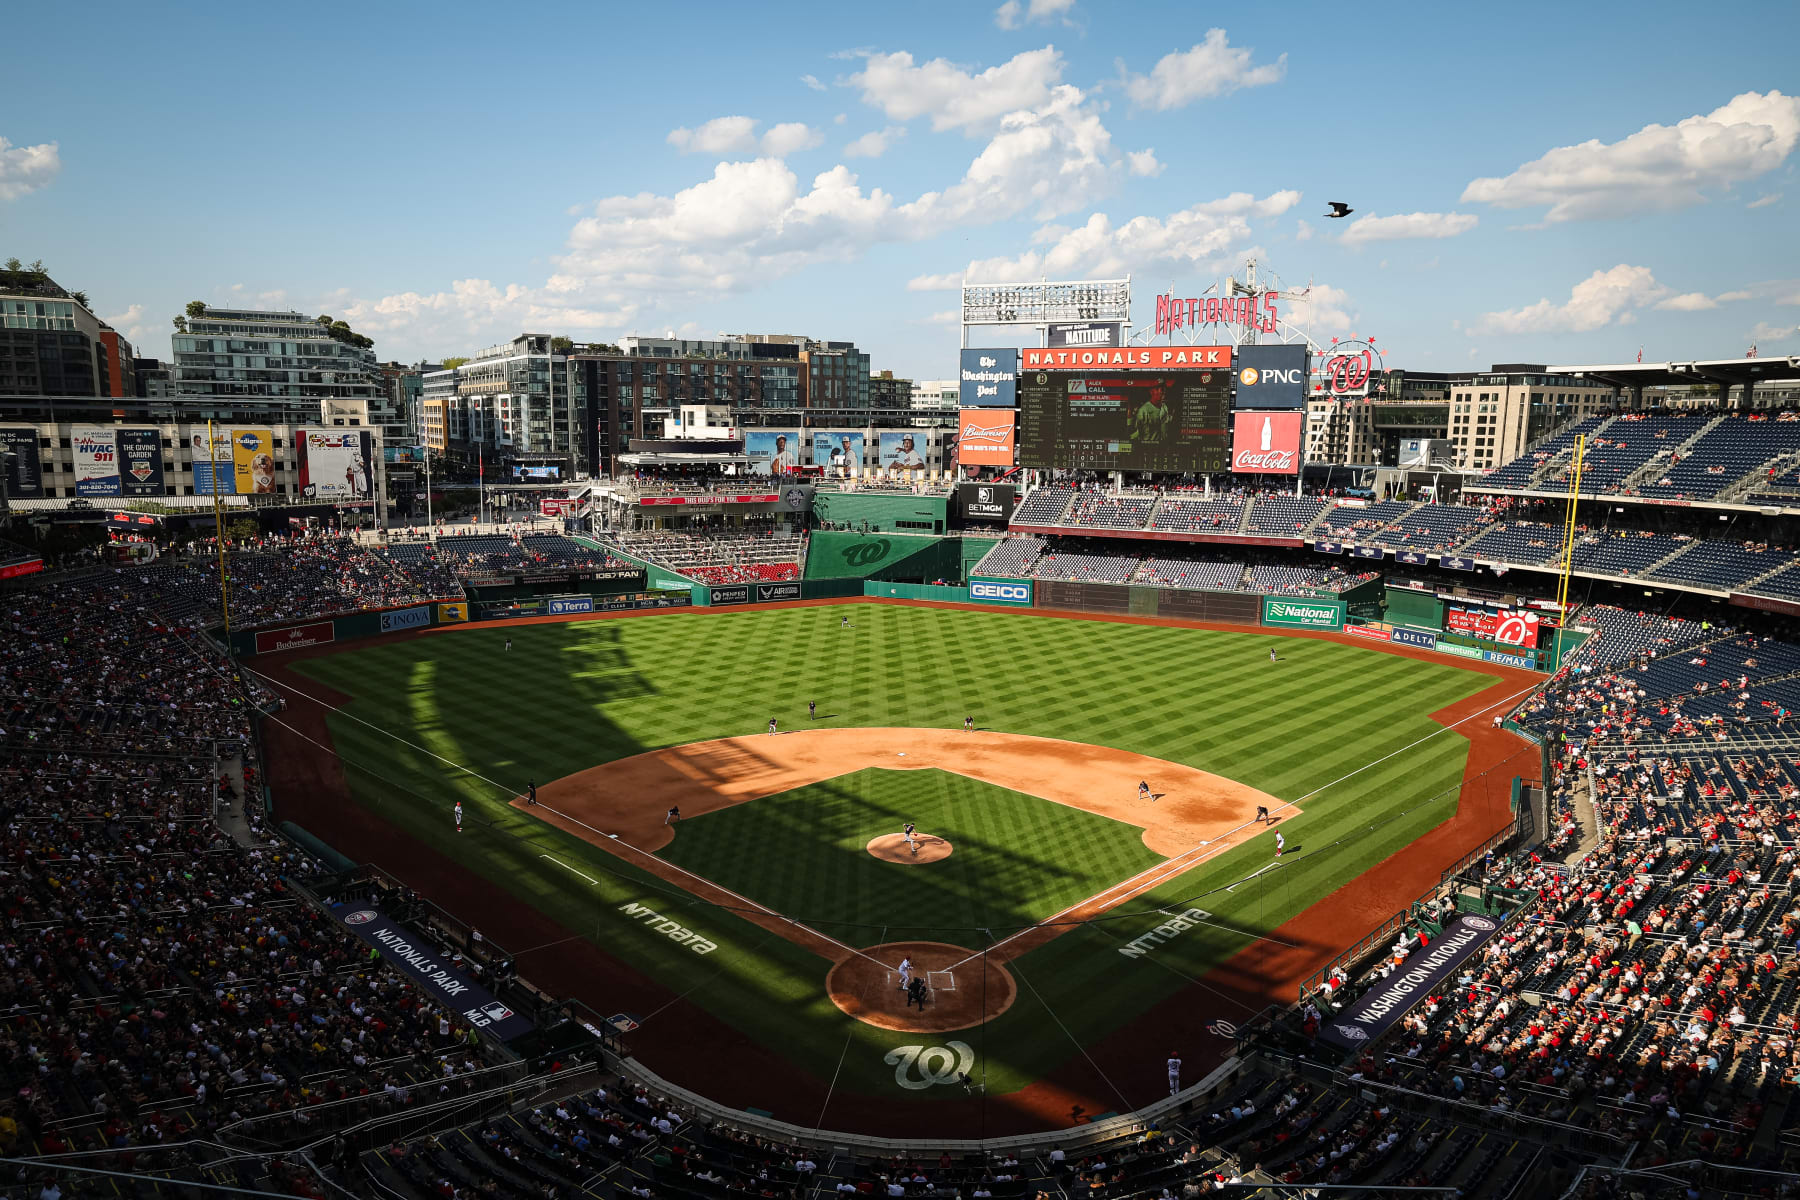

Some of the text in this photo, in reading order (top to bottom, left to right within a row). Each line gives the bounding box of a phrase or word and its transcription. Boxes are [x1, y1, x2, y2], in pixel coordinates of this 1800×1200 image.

[1155, 292, 1278, 334] NATIONALS
[1066, 328, 1110, 344] NATITUDE
[980, 356, 996, 368] The
[1030, 351, 1220, 364] NATIONALS PARK
[962, 368, 1014, 383] Washington
[1262, 368, 1302, 384] PNC
[976, 385, 998, 398] Post
[964, 427, 1008, 438] Budweiser
[94, 453, 113, 462] 911
[1213, 460, 1220, 469] 0
[972, 585, 1027, 599] GEICO
[563, 602, 590, 611] Terra
[1754, 598, 1794, 612] Budweiser
[393, 611, 428, 626] INOVA
[276, 637, 317, 650] Budweiser
[1403, 632, 1434, 645] DELTA
[1438, 644, 1475, 656] amentum
[1490, 653, 1526, 667] RE/MAX
[372, 928, 469, 996] NATIONALS PARK
[1354, 928, 1478, 1024] WASHINGTON NATIONALS
[463, 1008, 492, 1027] MLB
